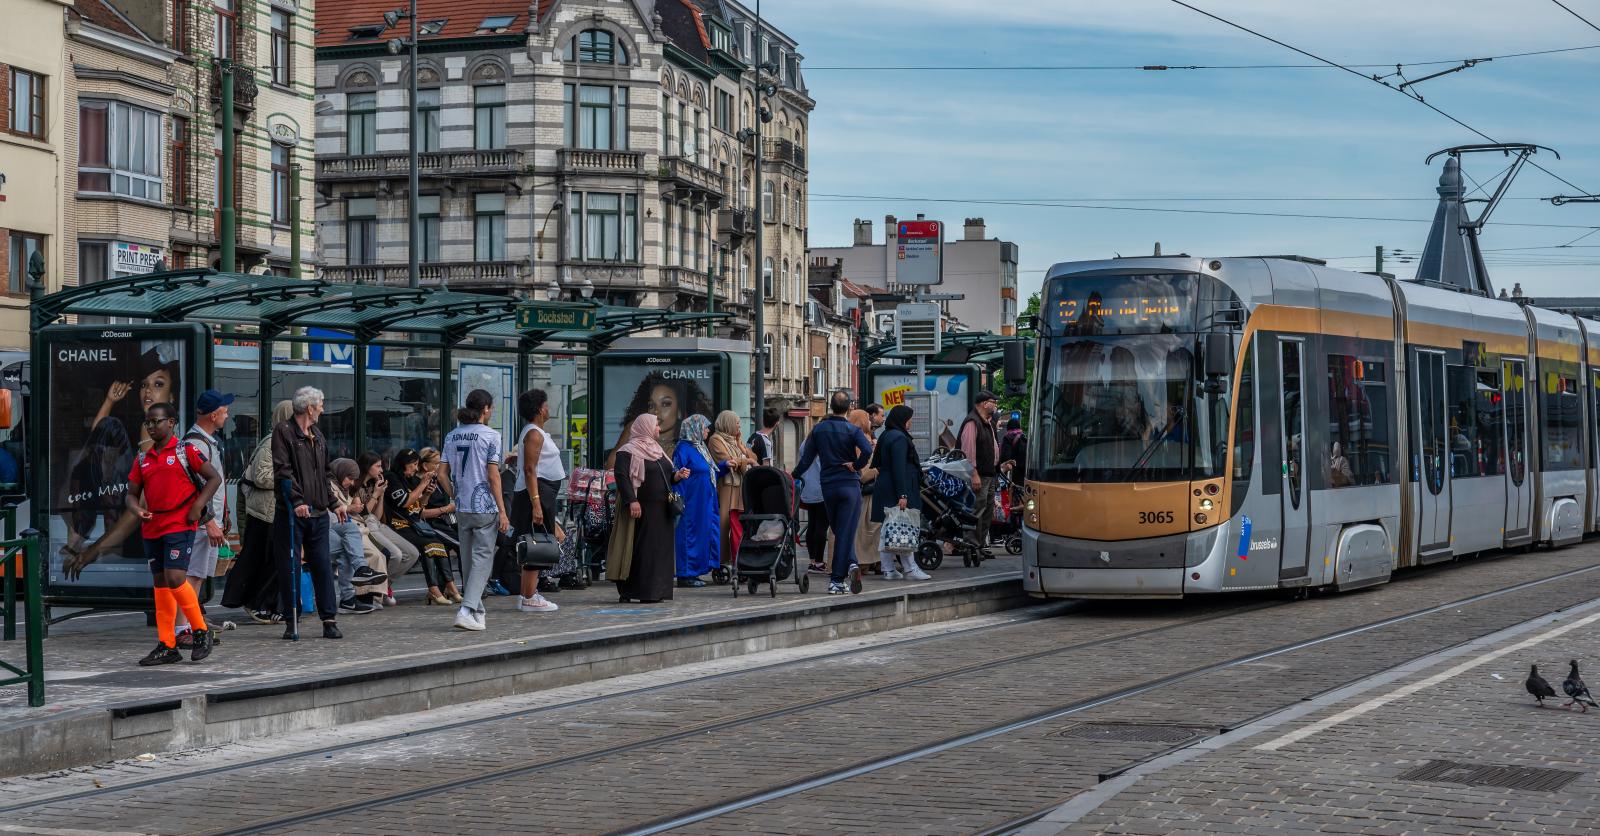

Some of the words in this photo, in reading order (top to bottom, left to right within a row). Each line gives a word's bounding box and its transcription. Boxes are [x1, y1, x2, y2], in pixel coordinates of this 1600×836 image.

[117, 249, 138, 265] PRINT
[140, 252, 160, 267] PRESS
[537, 309, 575, 324] Bockstael
[101, 330, 133, 338] JCDecaux
[58, 349, 117, 362] CHANEL
[662, 369, 711, 379] CHANEL
[456, 445, 470, 477] 7
[1138, 511, 1174, 524] 3065
